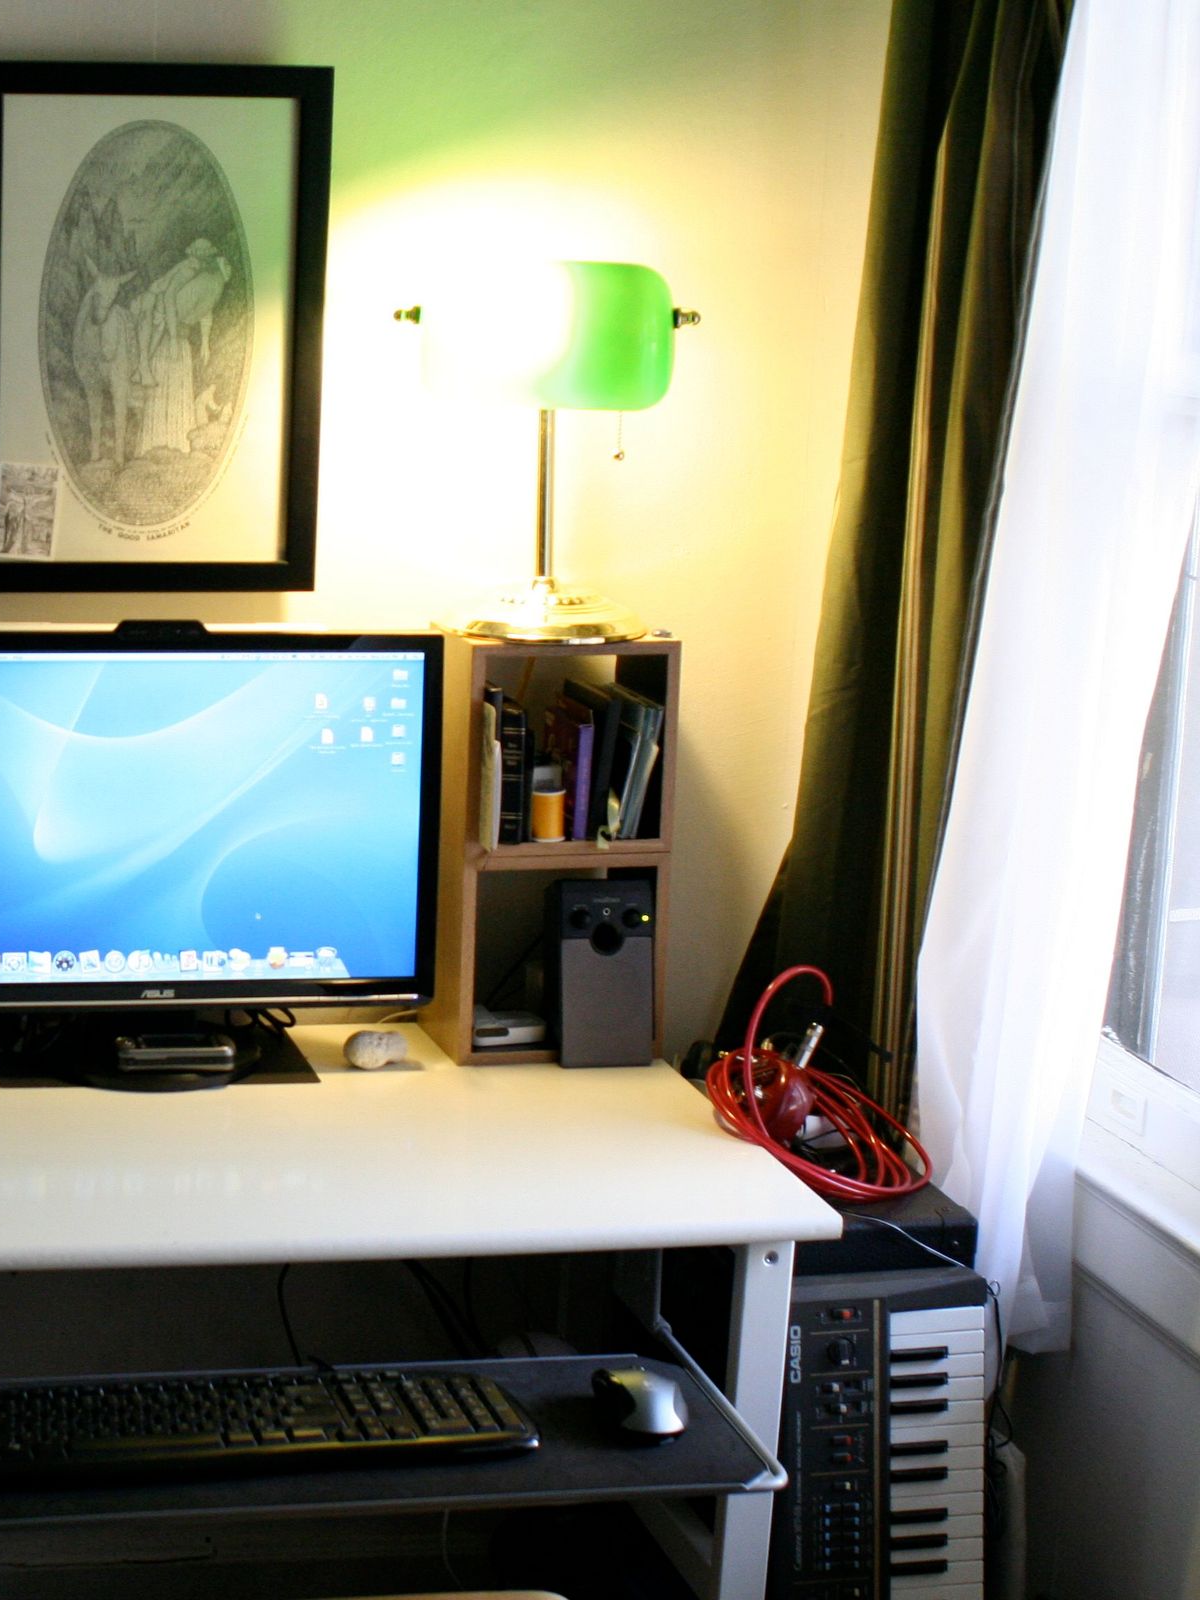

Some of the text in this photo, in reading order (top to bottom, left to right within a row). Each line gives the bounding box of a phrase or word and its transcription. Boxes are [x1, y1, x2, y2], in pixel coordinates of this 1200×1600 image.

[117, 531, 141, 542] GOOD
[146, 521, 191, 541] SAMARITAN
[140, 989, 175, 999] ASUS
[790, 1325, 801, 1384] CASIO
